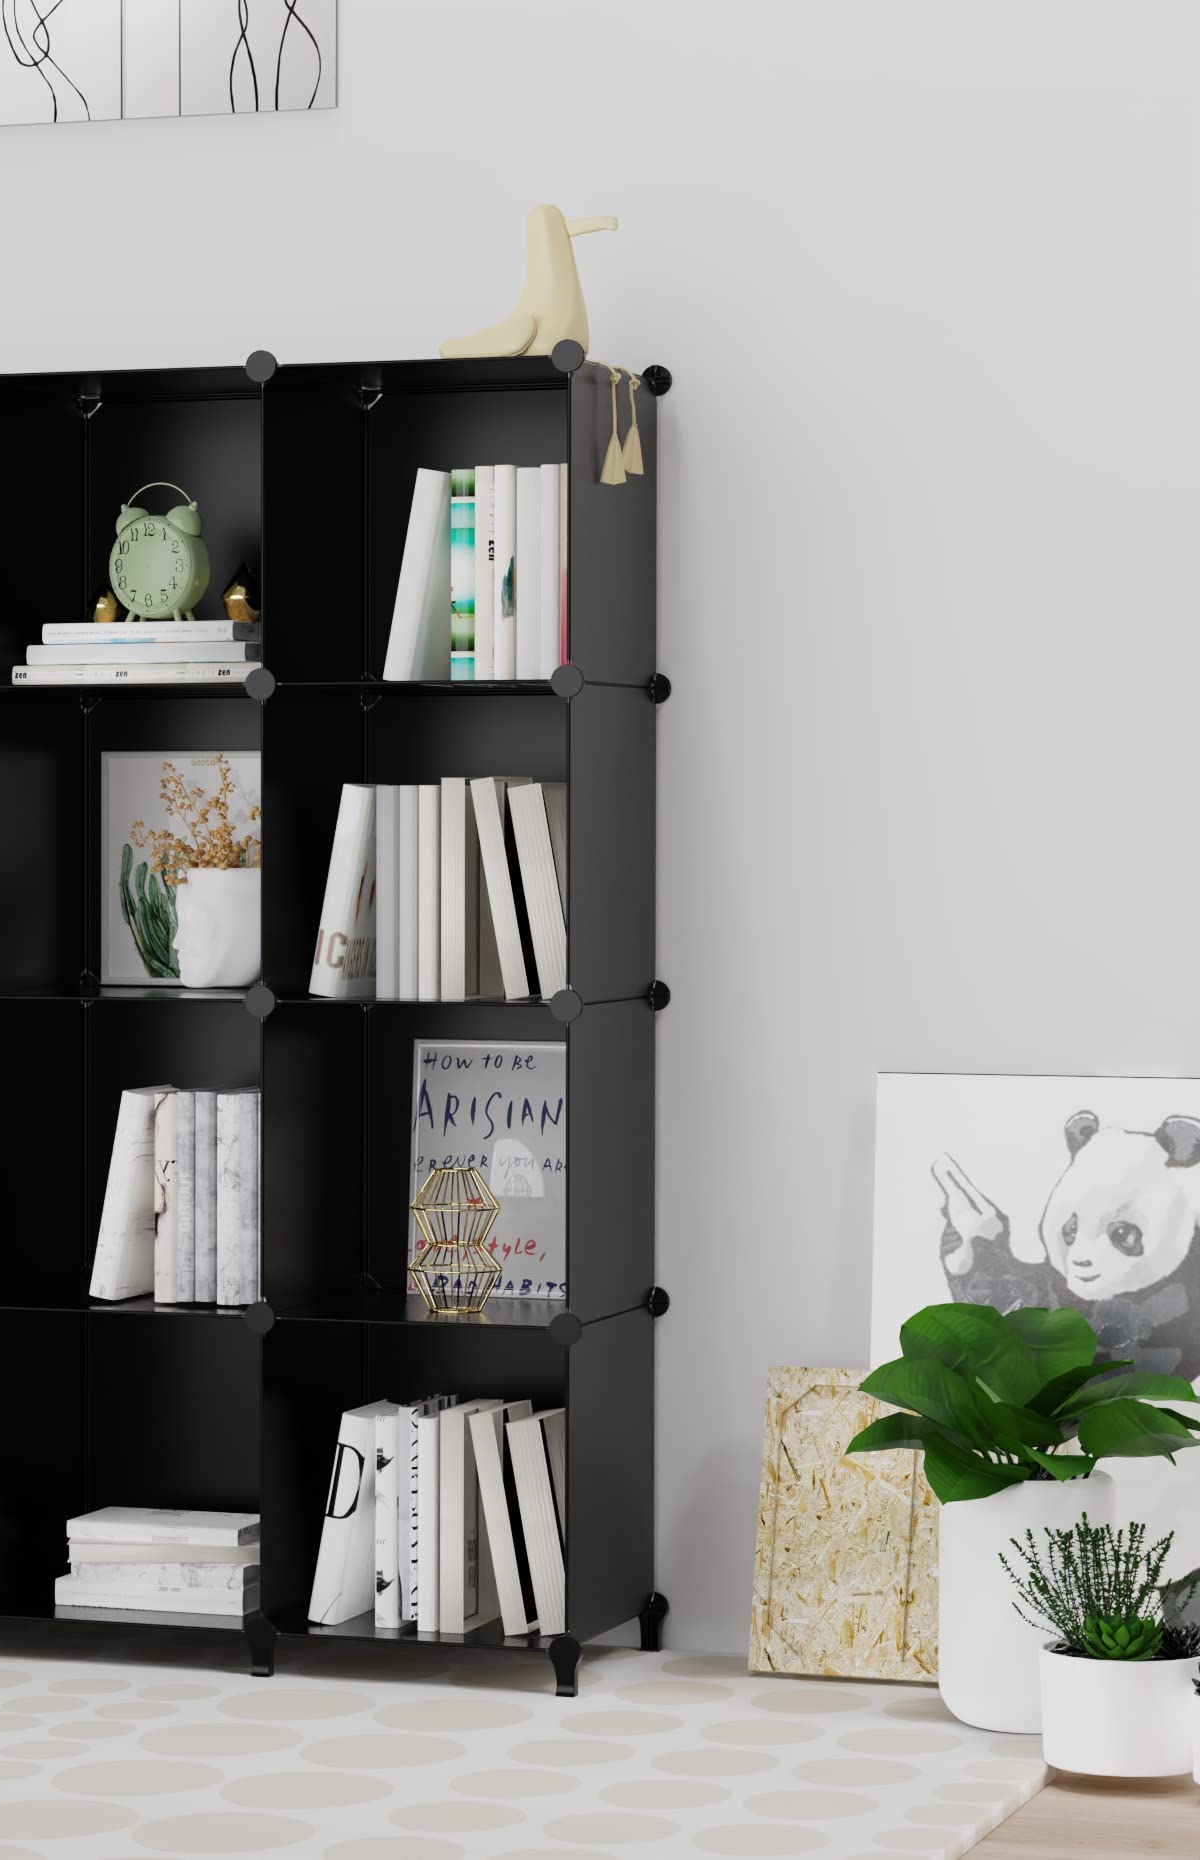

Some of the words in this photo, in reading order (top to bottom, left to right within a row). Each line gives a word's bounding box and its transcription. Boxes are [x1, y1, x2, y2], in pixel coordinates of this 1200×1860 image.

[131, 528, 139, 541] 11
[143, 523, 155, 536] 12
[162, 527, 167, 540] 1
[119, 541, 129, 554] 10
[171, 539, 180, 553] 2
[115, 558, 123, 573] 9
[175, 558, 184, 573] 3
[118, 575, 127, 589] 8
[168, 575, 178, 589] 4
[130, 589, 137, 603] 7
[144, 592, 152, 607] 6
[160, 588, 168, 603] 5
[14, 670, 27, 679] zen
[115, 669, 128, 678] zen
[217, 668, 230, 676] zen
